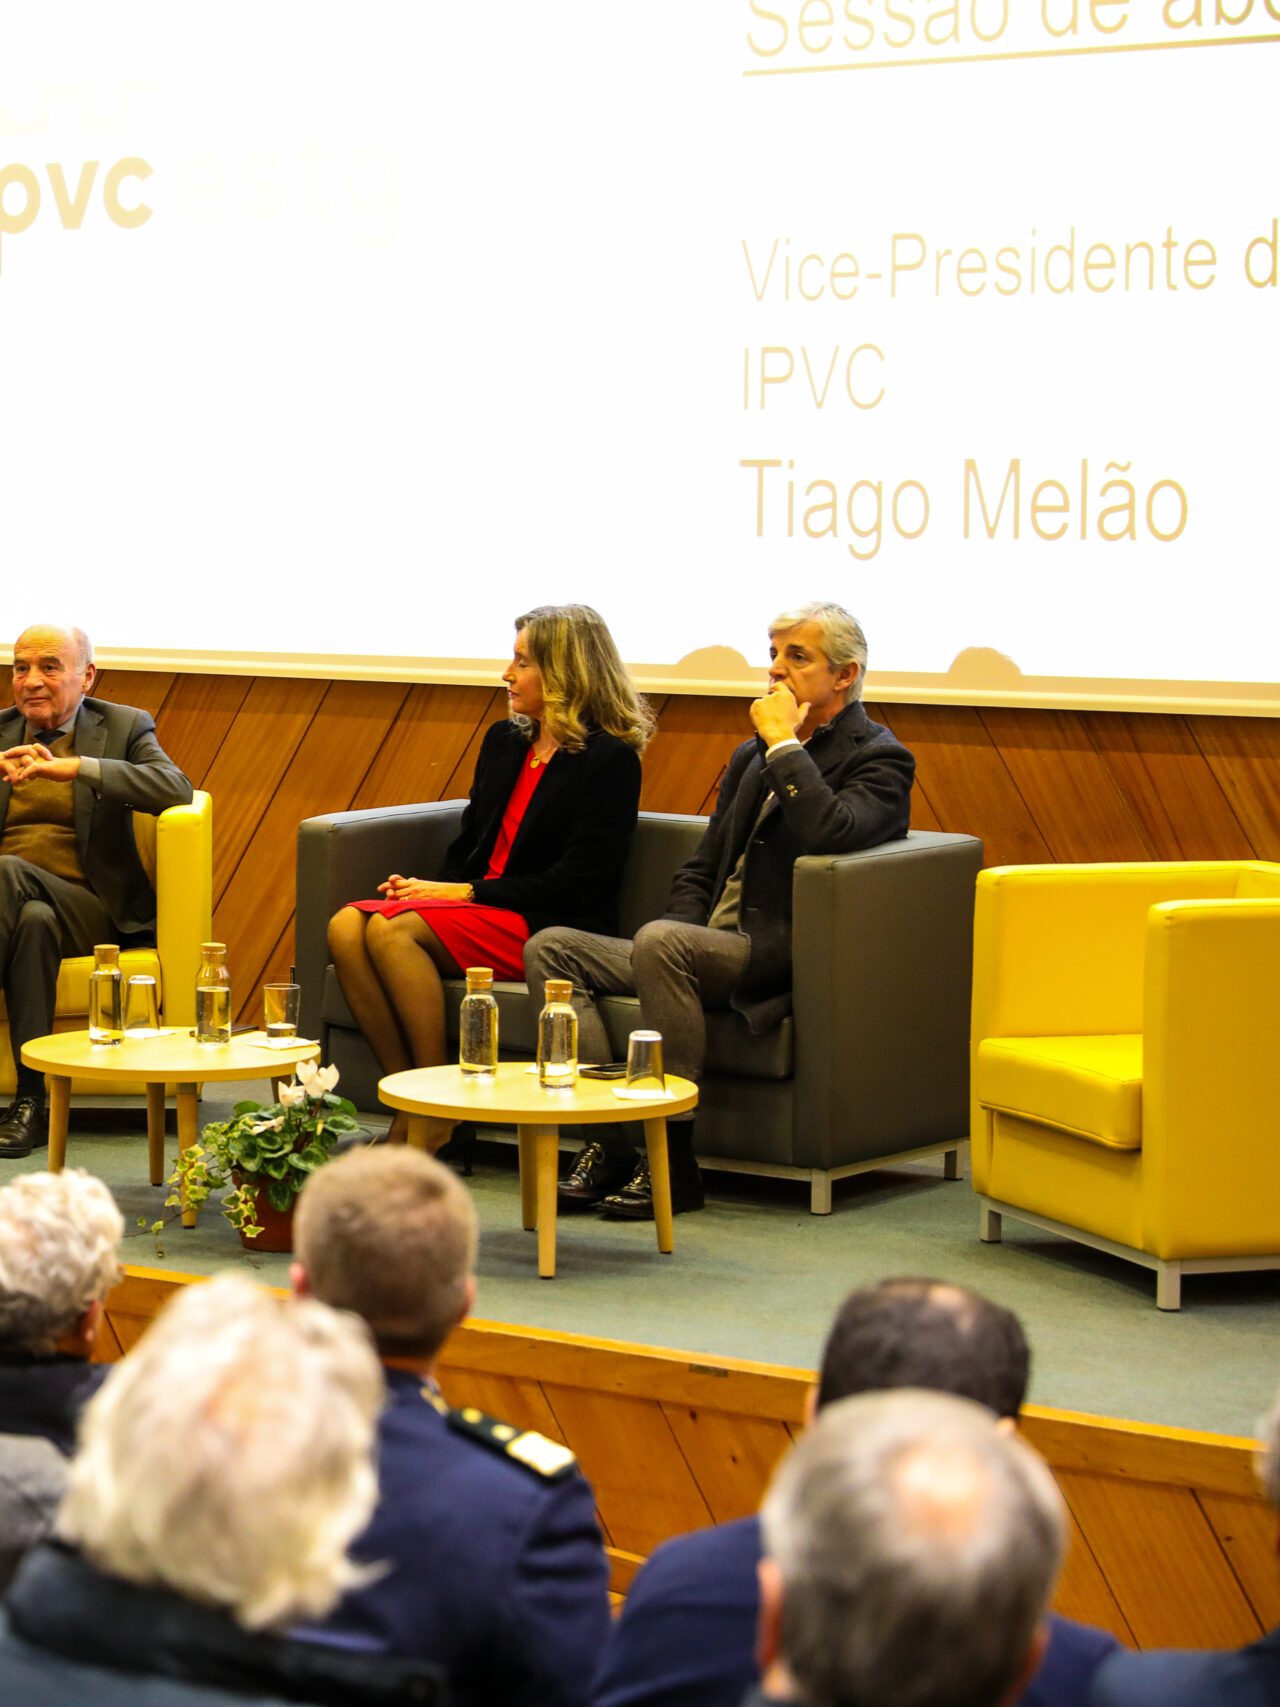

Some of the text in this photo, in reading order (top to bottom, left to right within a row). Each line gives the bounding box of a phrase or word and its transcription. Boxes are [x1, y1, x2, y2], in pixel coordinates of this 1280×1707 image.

[741, 225, 1219, 303] Vice-Presidente
[743, 342, 886, 411] IPVC
[738, 457, 1190, 561] Tiago Melão
